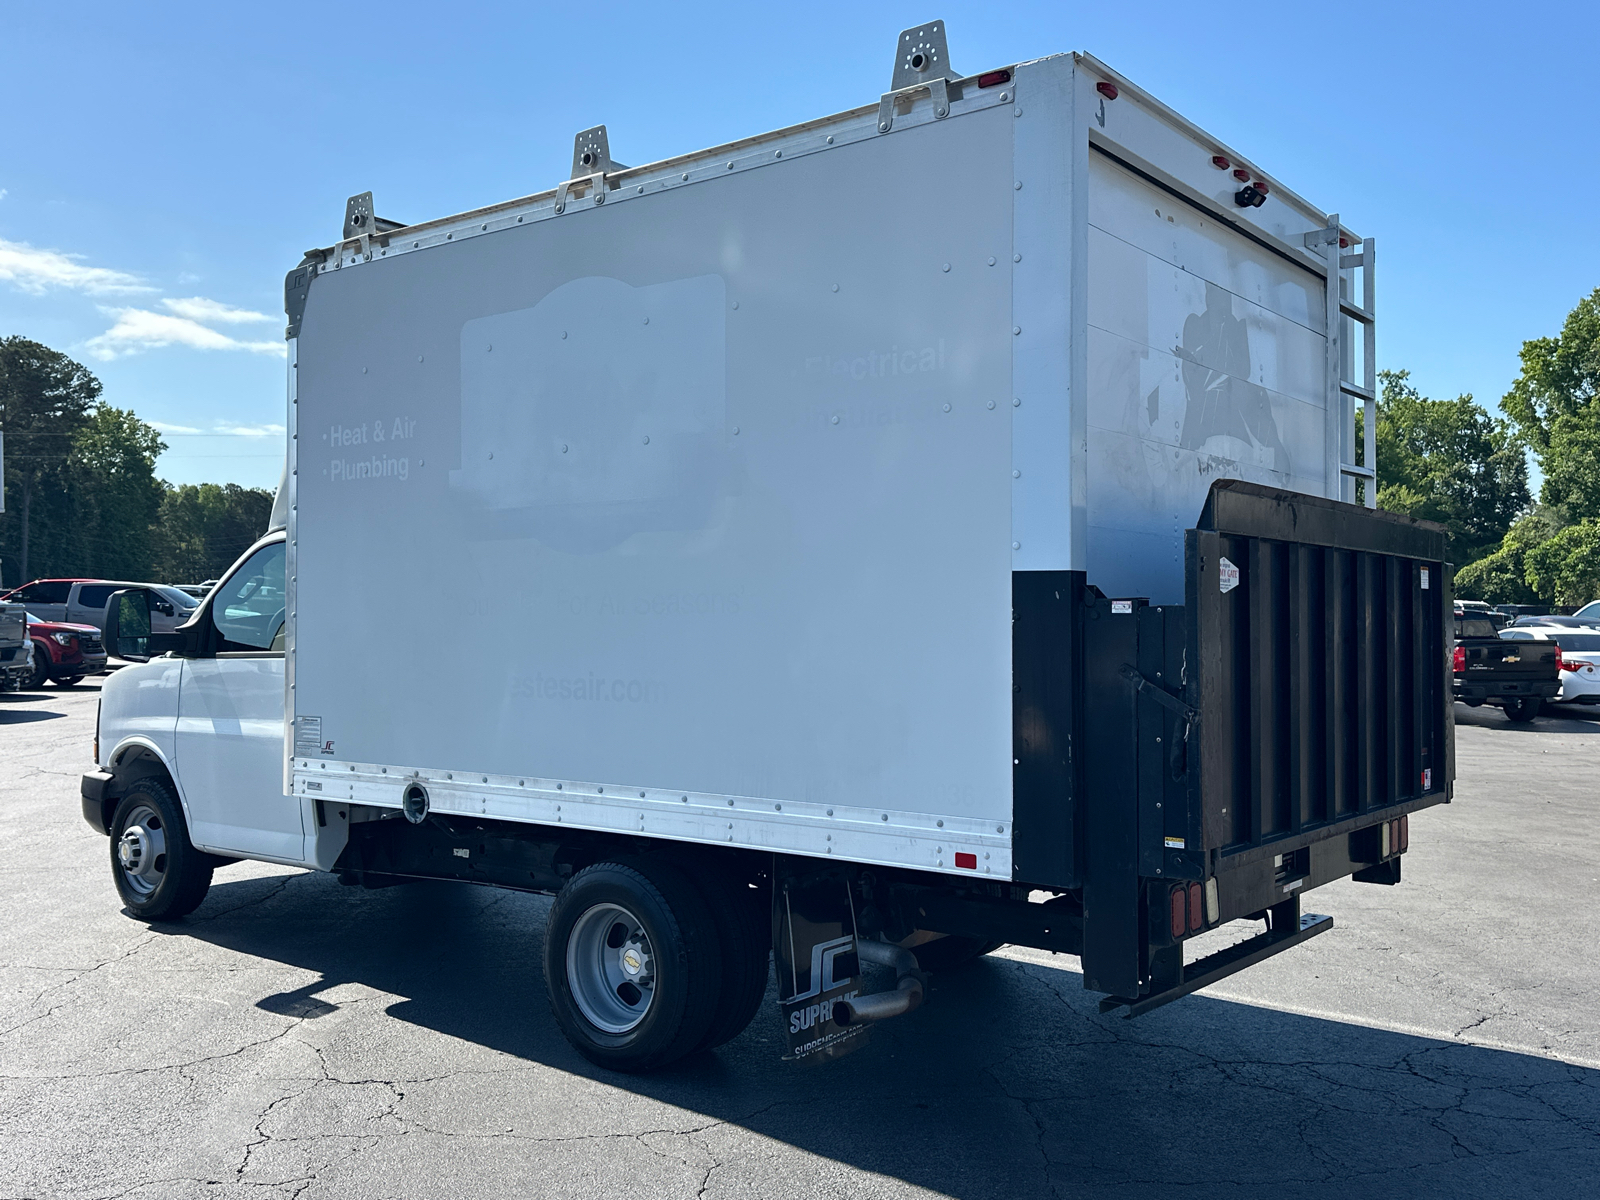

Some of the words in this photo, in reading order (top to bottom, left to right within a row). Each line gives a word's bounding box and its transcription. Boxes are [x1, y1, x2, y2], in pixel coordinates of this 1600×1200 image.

[330, 423, 368, 447] Heat
[373, 419, 385, 442] &
[391, 416, 416, 440] Air
[330, 454, 409, 482] Plumbing
